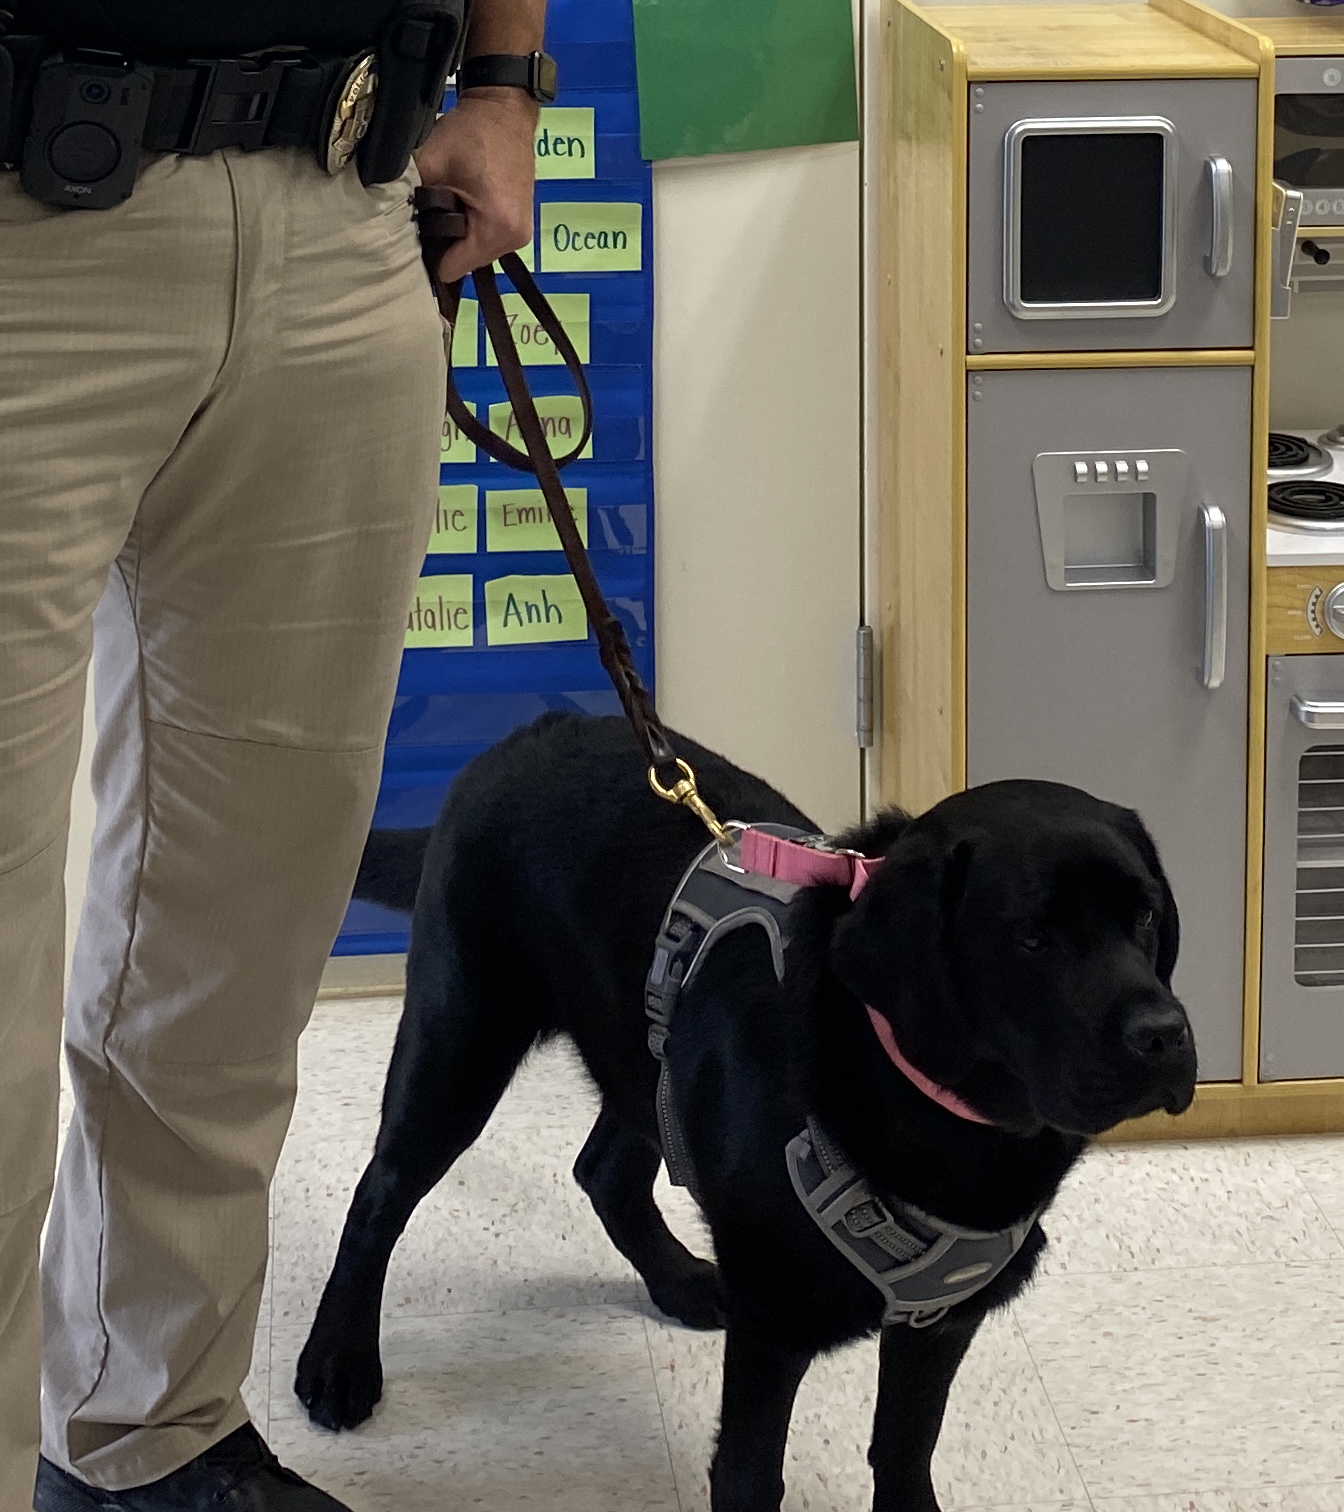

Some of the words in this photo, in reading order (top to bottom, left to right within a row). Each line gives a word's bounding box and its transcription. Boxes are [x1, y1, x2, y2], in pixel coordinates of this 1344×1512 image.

[537, 128, 586, 159] den
[553, 223, 628, 252] Ocean
[506, 313, 561, 355] Zoe
[435, 497, 468, 534] lie
[502, 589, 563, 628] Anh
